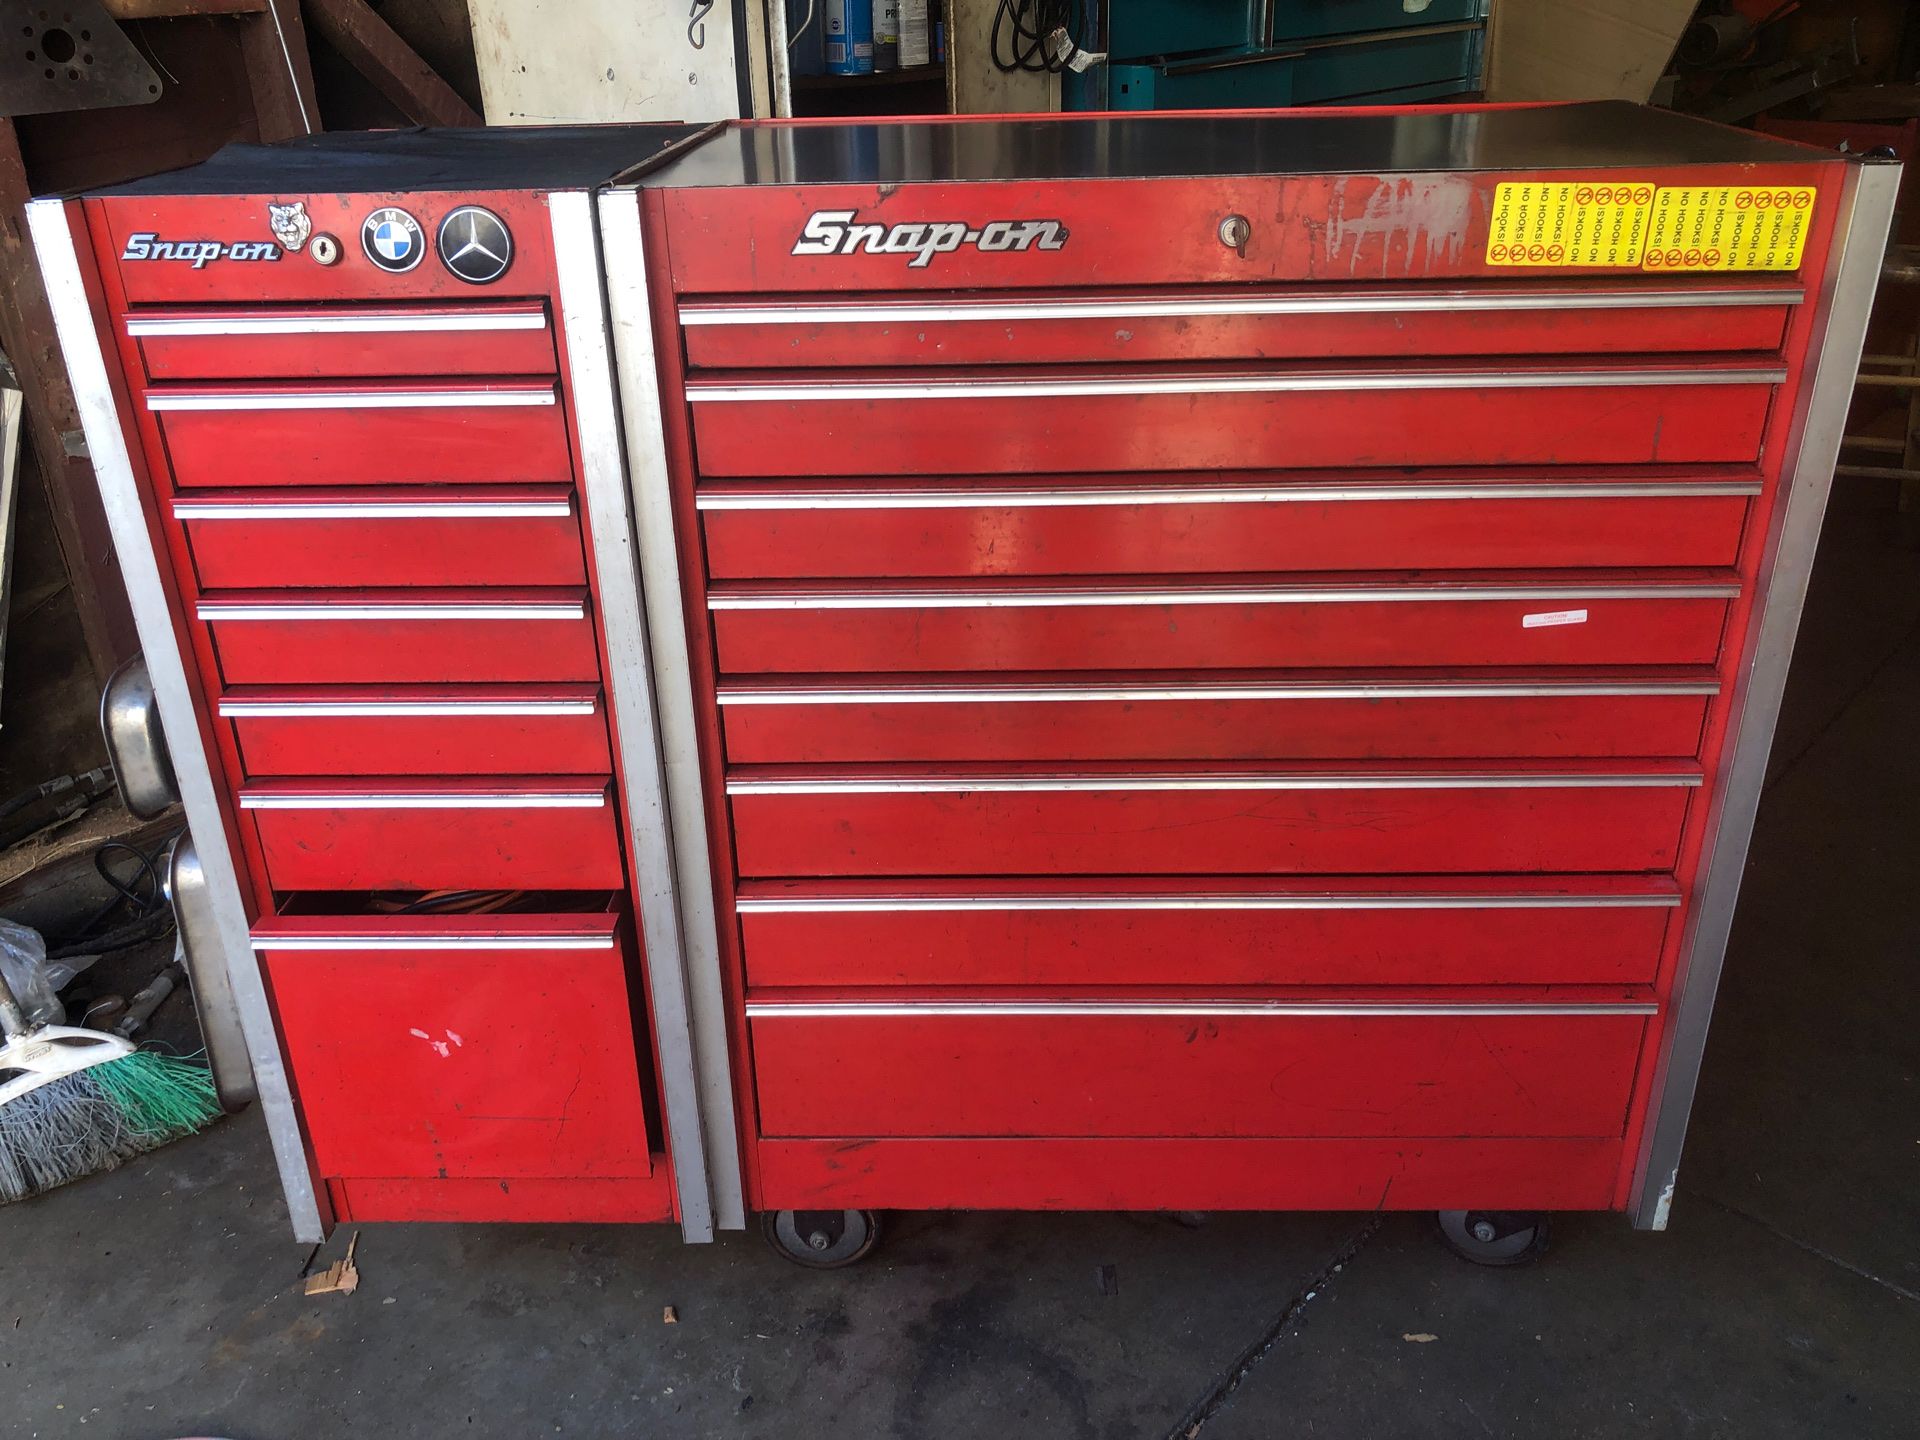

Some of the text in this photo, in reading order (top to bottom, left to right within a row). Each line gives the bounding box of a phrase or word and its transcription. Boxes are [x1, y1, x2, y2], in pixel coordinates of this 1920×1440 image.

[367, 210, 417, 233] BMW
[792, 209, 1069, 267] Snap-on
[1497, 187, 1512, 243] NO HOOKS!
[1515, 187, 1531, 243] NO HOOKS!
[1534, 187, 1550, 243] NO HOOKS!
[1553, 187, 1569, 243] NO HOOKS!
[1570, 207, 1586, 262] NO HOOKS!
[1589, 207, 1605, 262] NO HOOKS!
[1608, 207, 1624, 262] NO HOOKS!
[1627, 207, 1643, 262] NO HOOKS!
[1653, 191, 1671, 247] NO HOOKS!
[1672, 191, 1690, 247] NO HOOKS!
[1691, 191, 1709, 247] NO HOOKS!
[1710, 191, 1729, 247] NO HOOKS!
[1727, 211, 1746, 266] NO HOOKS!
[1746, 211, 1765, 266] NO HOOKS!
[1765, 211, 1784, 266] NO HOOKS!
[1784, 211, 1803, 266] NO HOOKS!
[121, 232, 284, 269] Snap-on
